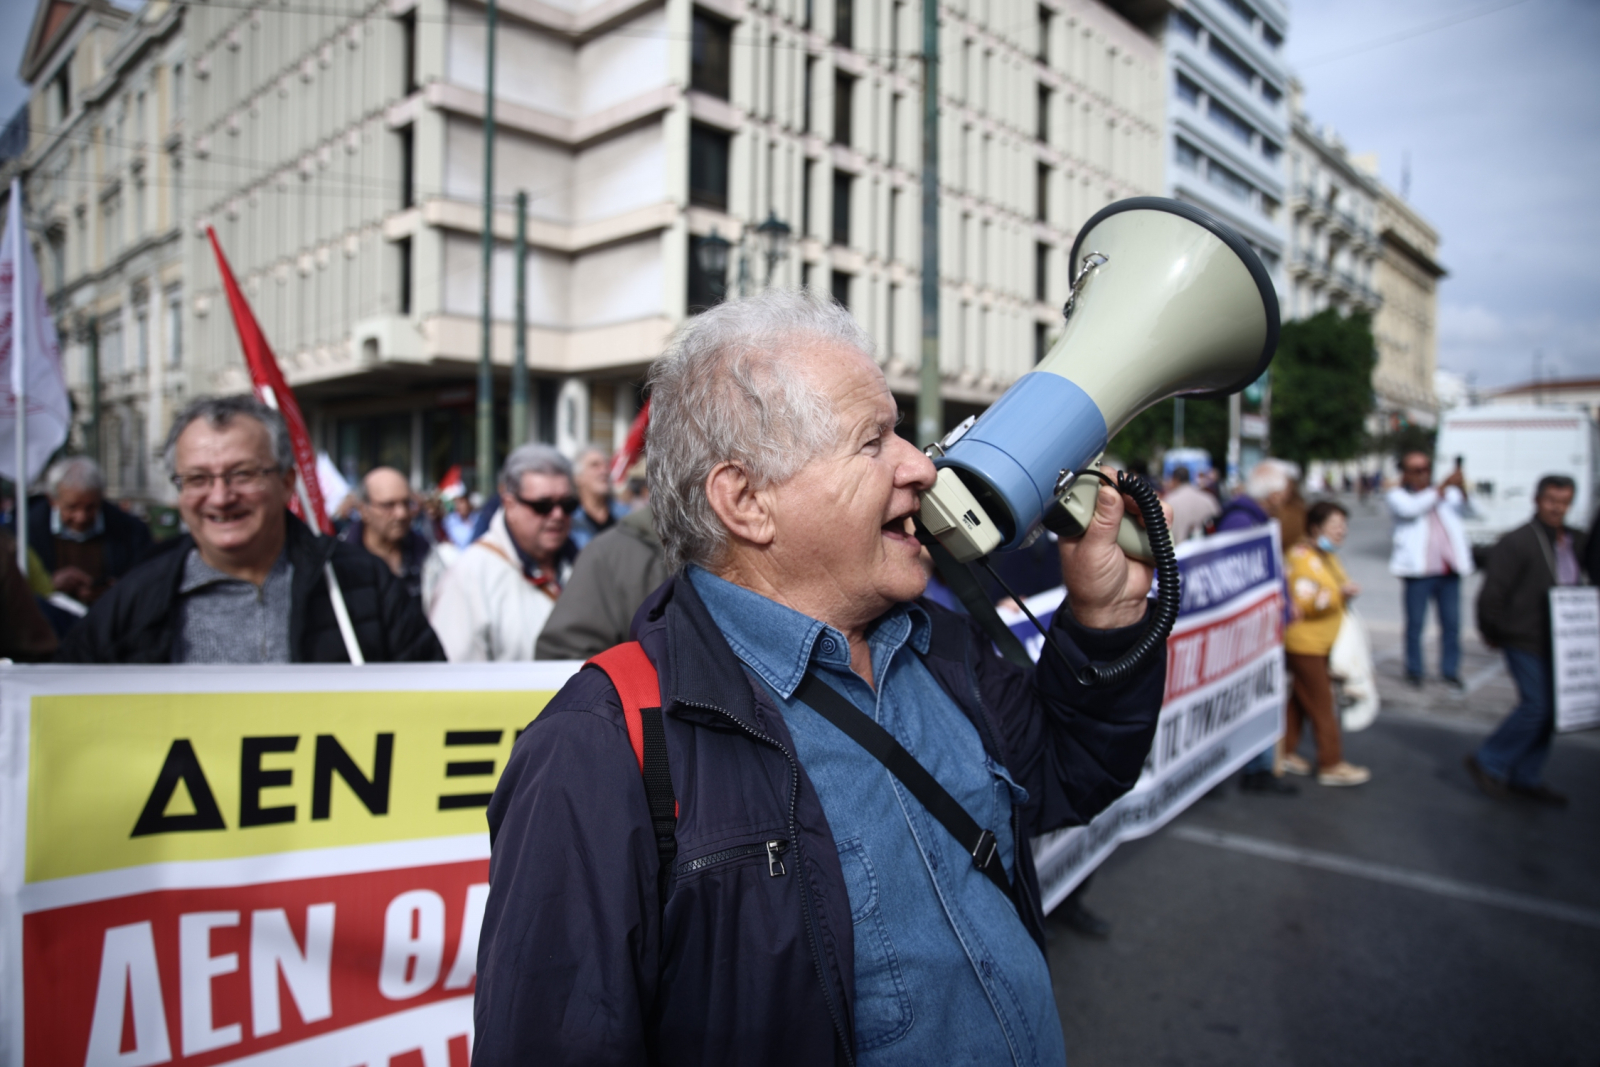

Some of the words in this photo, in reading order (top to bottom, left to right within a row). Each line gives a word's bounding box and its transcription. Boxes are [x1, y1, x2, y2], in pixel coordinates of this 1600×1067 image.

[129, 732, 395, 839] ΔΕΝ
[437, 729, 525, 812] Ξ
[84, 903, 336, 1067] ΔΕΝ
